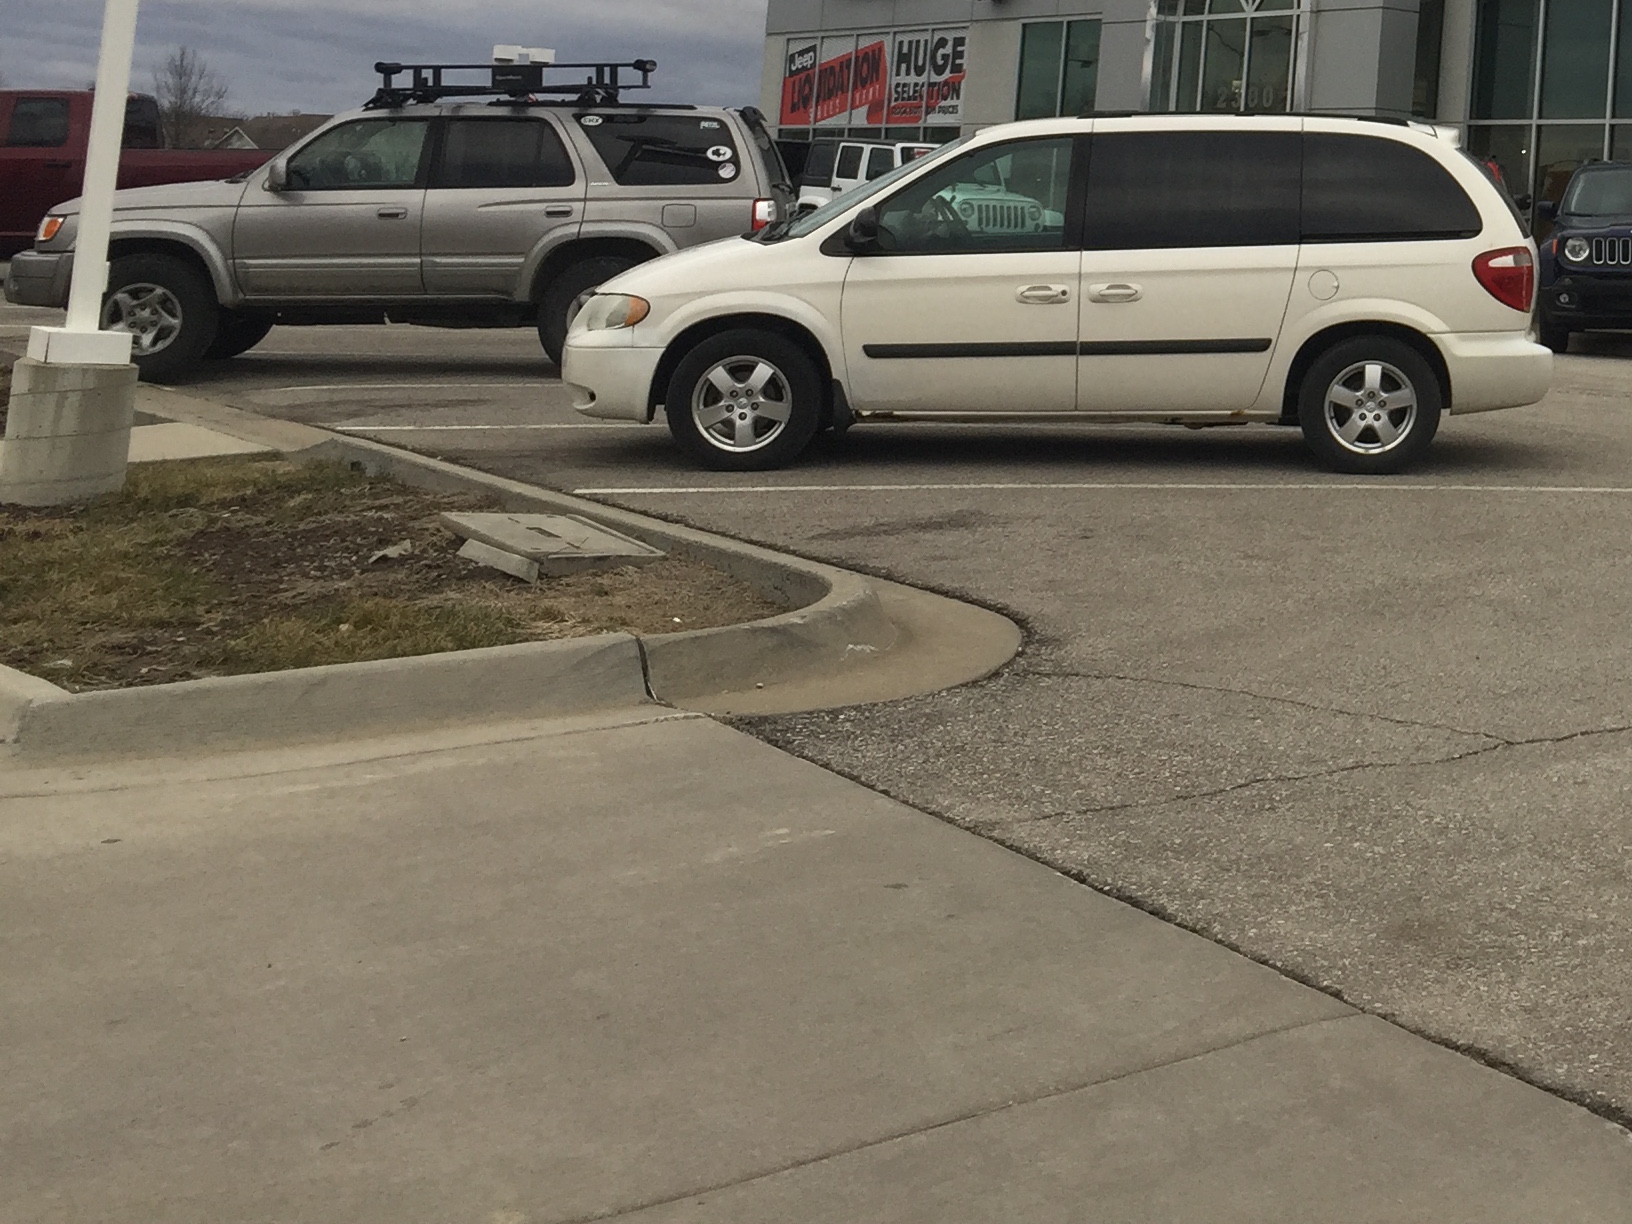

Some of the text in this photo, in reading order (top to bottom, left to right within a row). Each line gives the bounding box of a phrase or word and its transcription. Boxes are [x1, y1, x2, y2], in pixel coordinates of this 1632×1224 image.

[790, 50, 815, 72] Jeep
[895, 36, 967, 77] HUGE
[790, 48, 883, 114] LIQUIDATION
[893, 81, 962, 103] SELECTION
